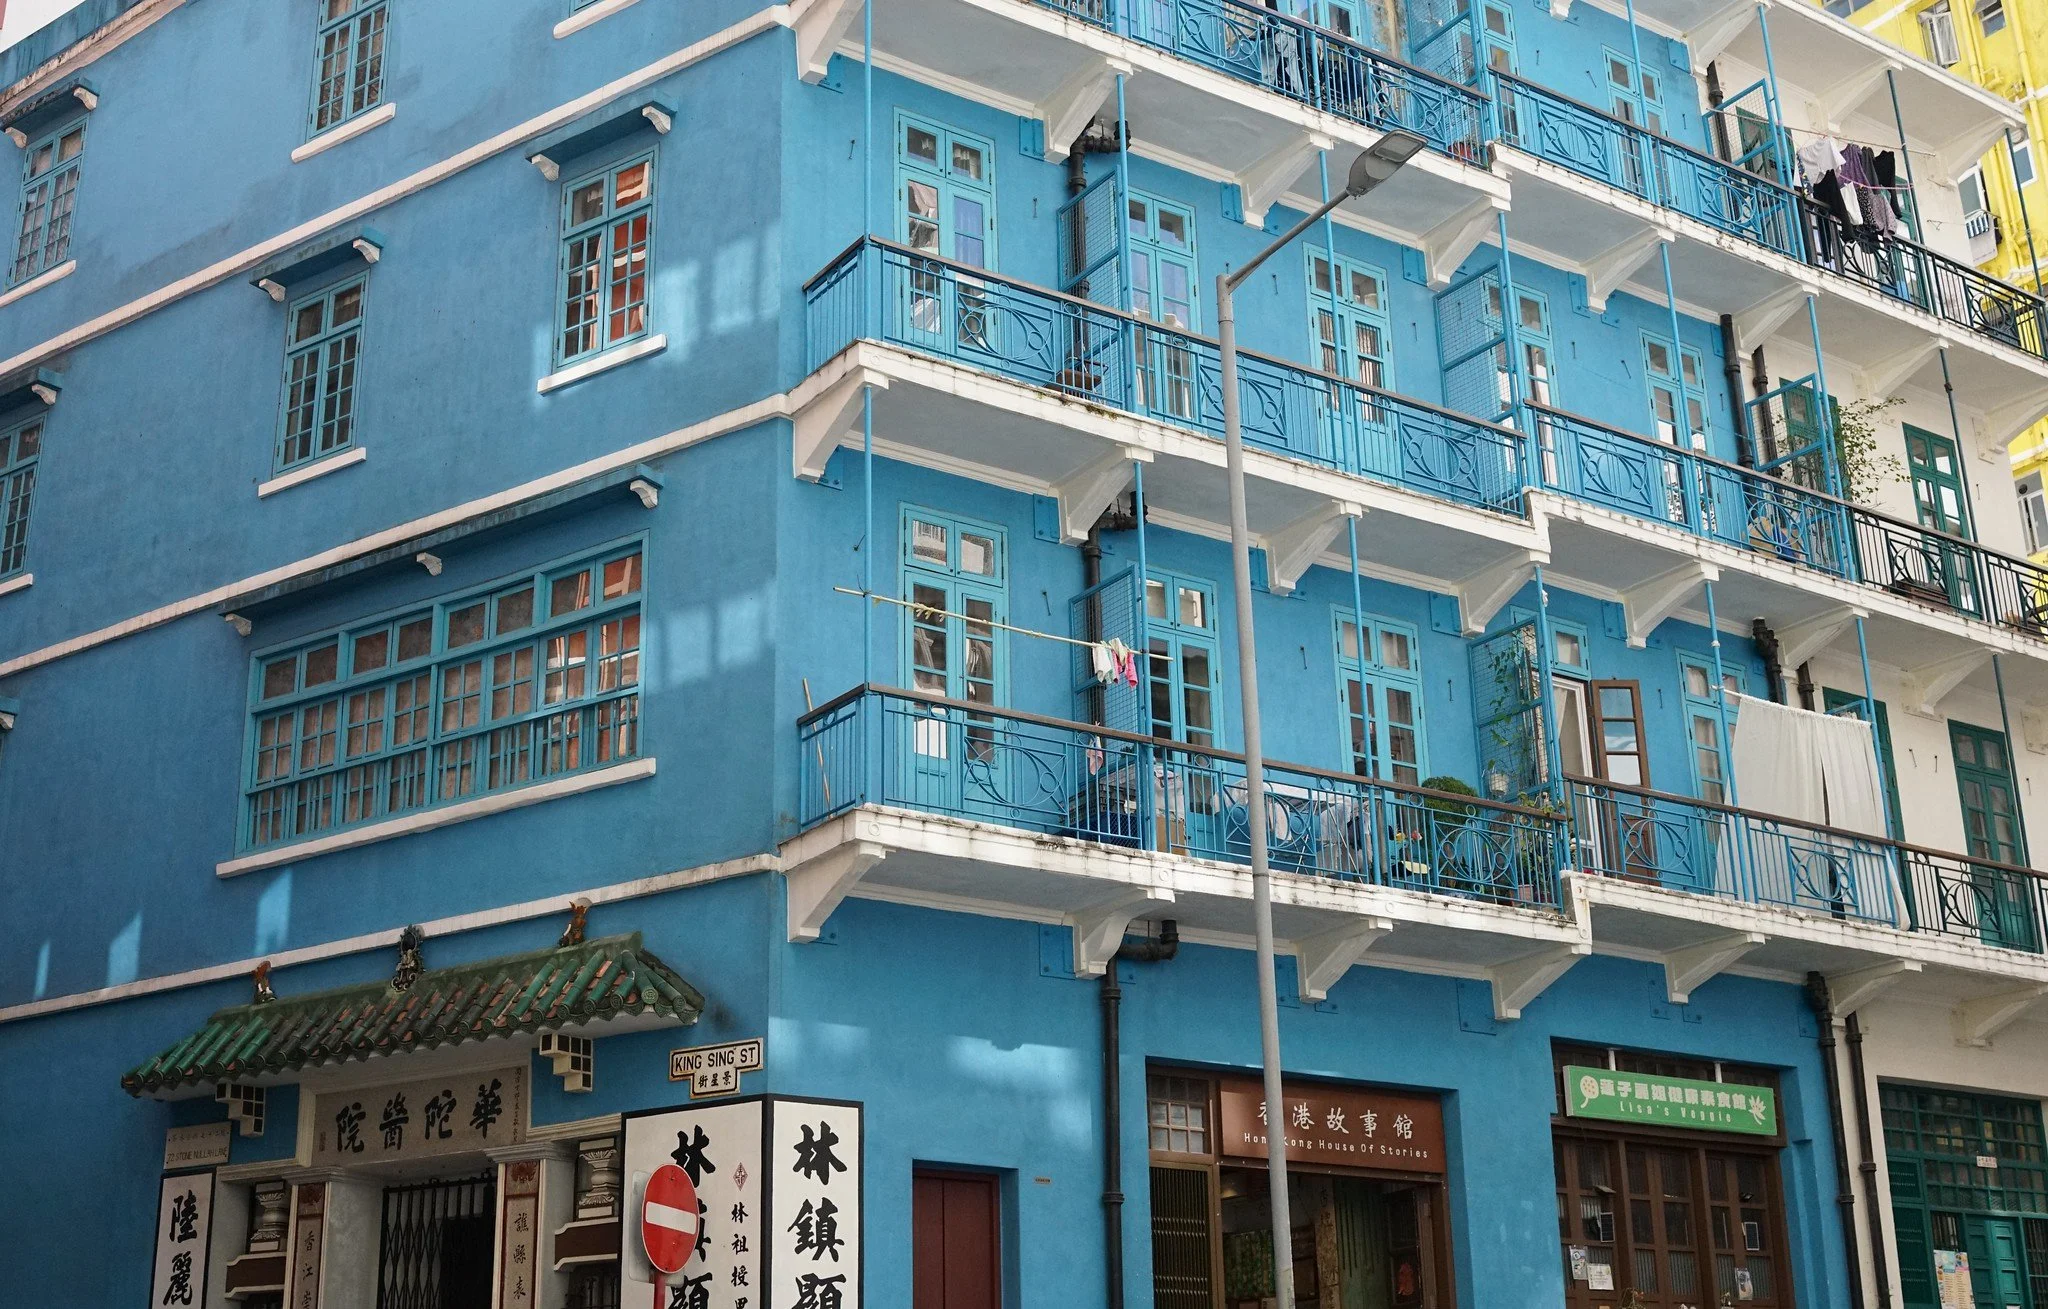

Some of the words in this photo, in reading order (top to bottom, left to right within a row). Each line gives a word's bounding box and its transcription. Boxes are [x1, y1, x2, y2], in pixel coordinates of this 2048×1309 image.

[675, 1054, 702, 1071] KING
[707, 1050, 734, 1067] SING
[740, 1047, 756, 1063] ST
[1620, 1101, 1670, 1117] Lisa's
[1681, 1107, 1732, 1123] Veggie
[1244, 1132, 1268, 1144] Hon
[1319, 1139, 1355, 1152] House
[1360, 1143, 1374, 1154] Of
[1380, 1145, 1428, 1159] Stories
